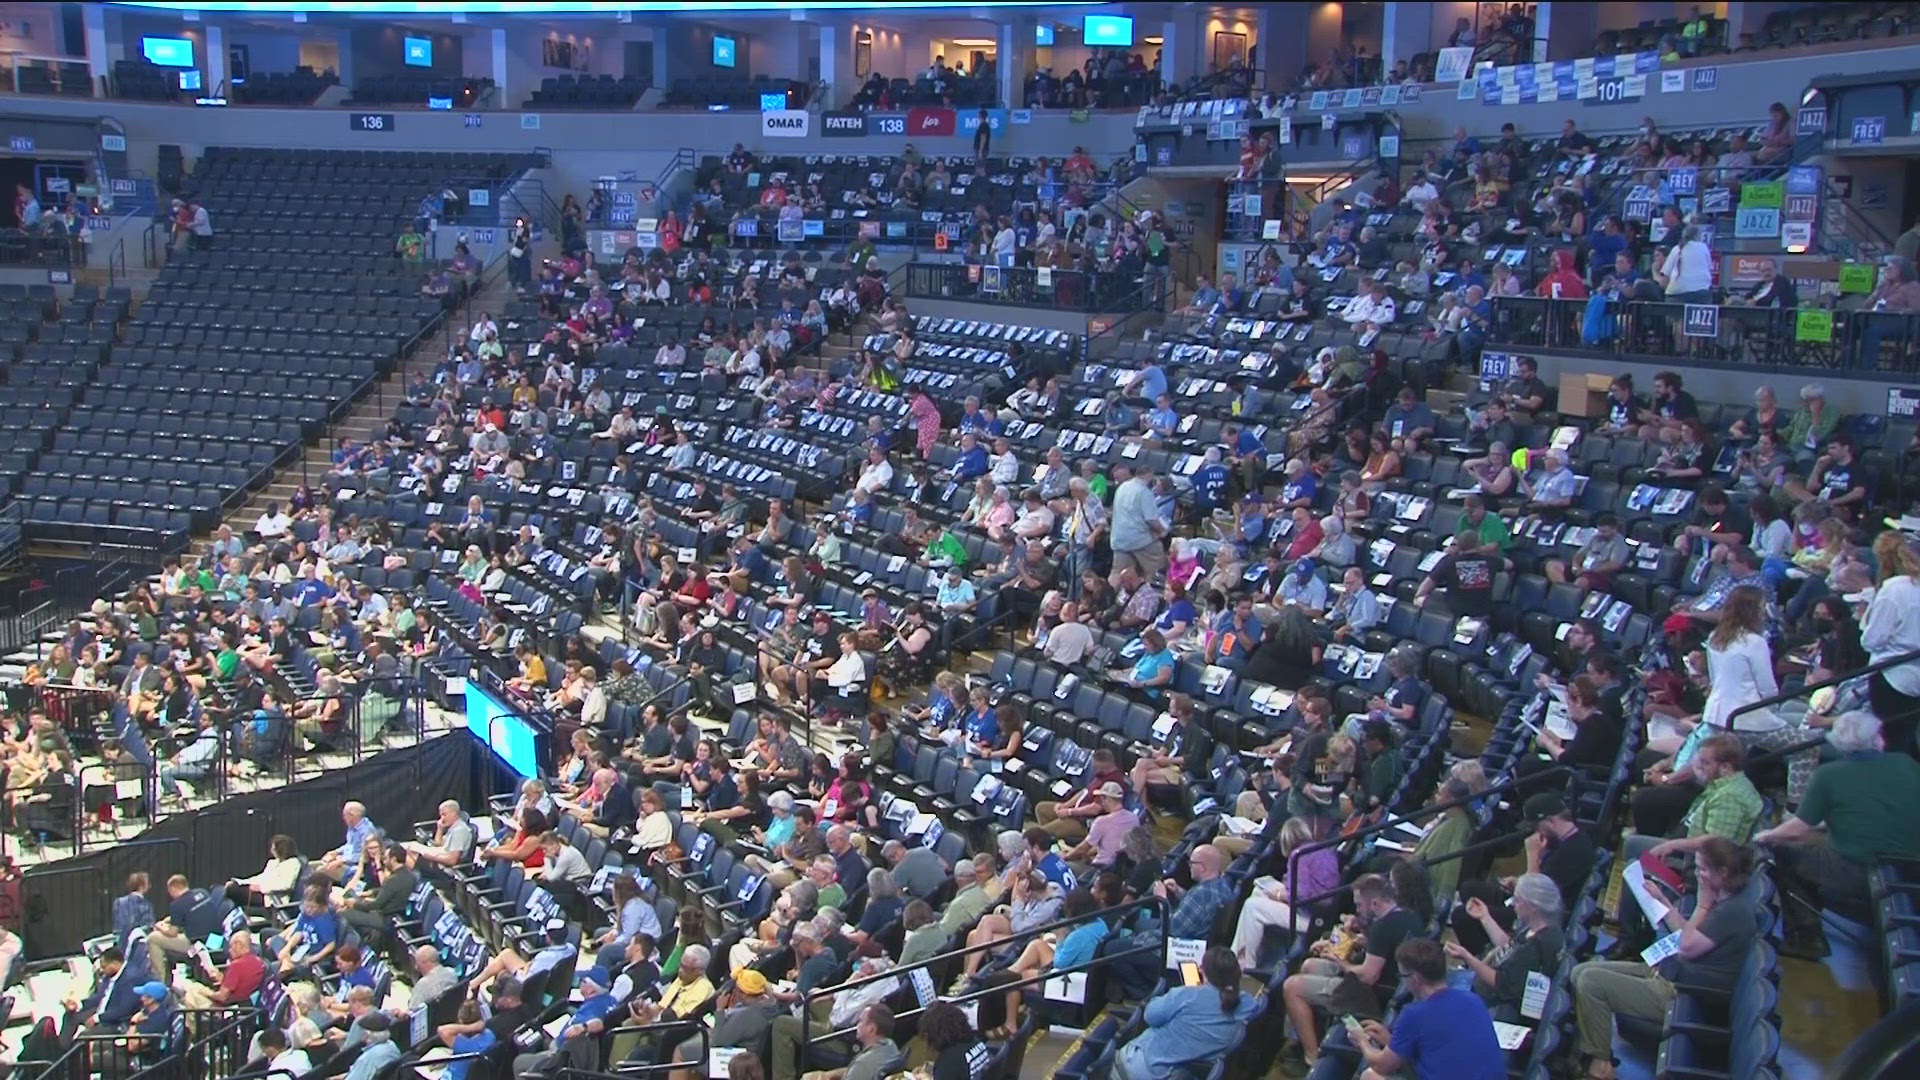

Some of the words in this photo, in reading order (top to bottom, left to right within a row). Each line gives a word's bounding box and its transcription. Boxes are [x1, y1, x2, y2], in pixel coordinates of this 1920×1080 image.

[1598, 81, 1624, 101] 101
[361, 116, 383, 129] 136
[767, 118, 804, 129] OMAR
[826, 117, 862, 129] FATEH
[879, 119, 904, 133] 138
[1801, 112, 1824, 126] JAZZ
[1854, 124, 1882, 138] FREY
[1669, 174, 1694, 188] FREY
[1627, 203, 1647, 217] JAZZ
[1789, 200, 1812, 213] JAZZ
[1742, 215, 1773, 229] JAZZ
[937, 235, 945, 247] 3
[1688, 310, 1714, 326] JAZZ
[1482, 359, 1505, 375] FREY
